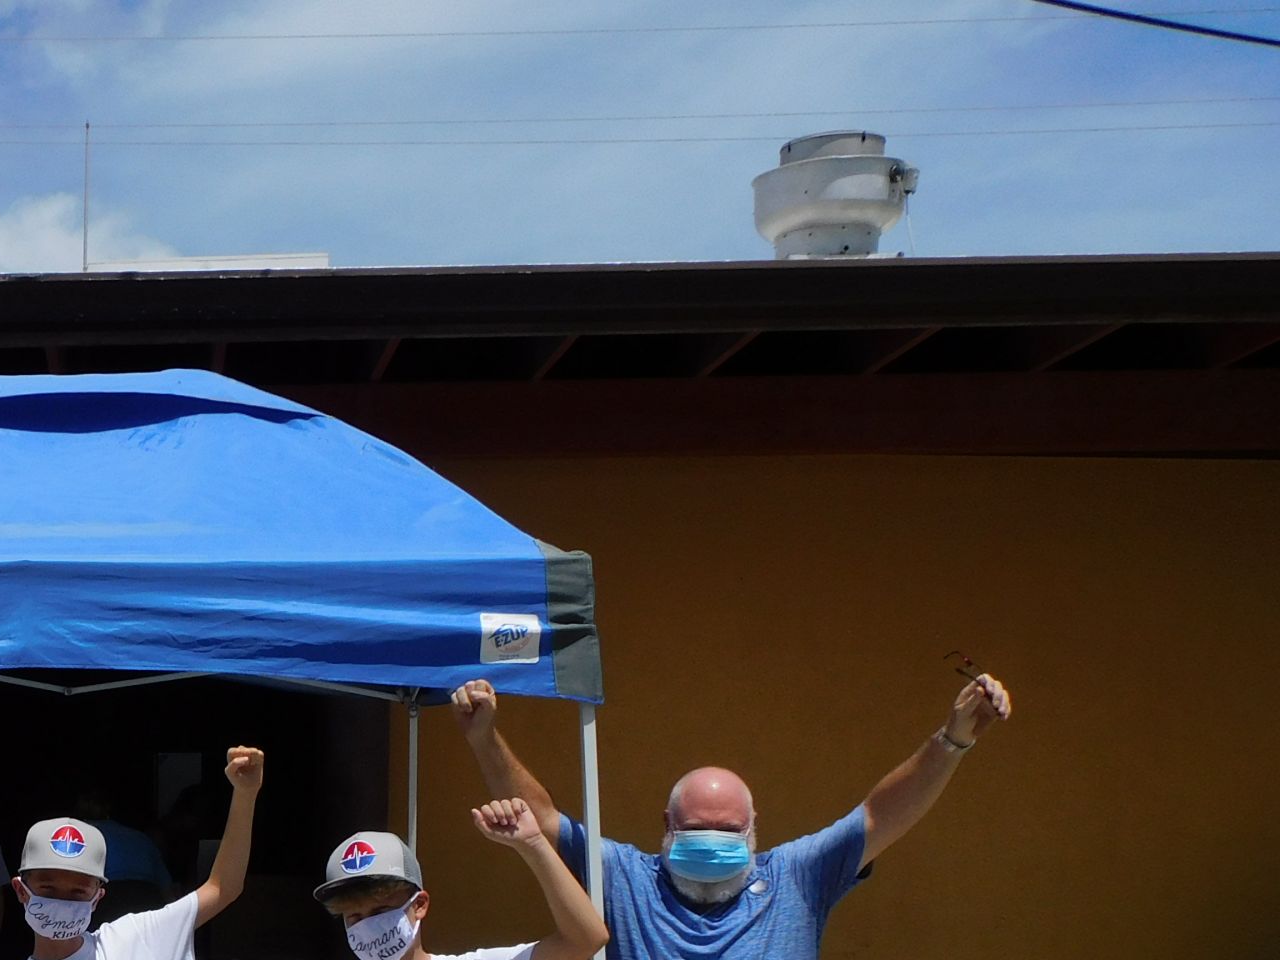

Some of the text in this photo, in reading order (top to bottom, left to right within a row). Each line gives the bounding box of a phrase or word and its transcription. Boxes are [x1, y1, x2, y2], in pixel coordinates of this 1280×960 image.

[28, 902, 86, 929] Cayman
[53, 928, 81, 939] Kind
[377, 938, 407, 960] Kind
